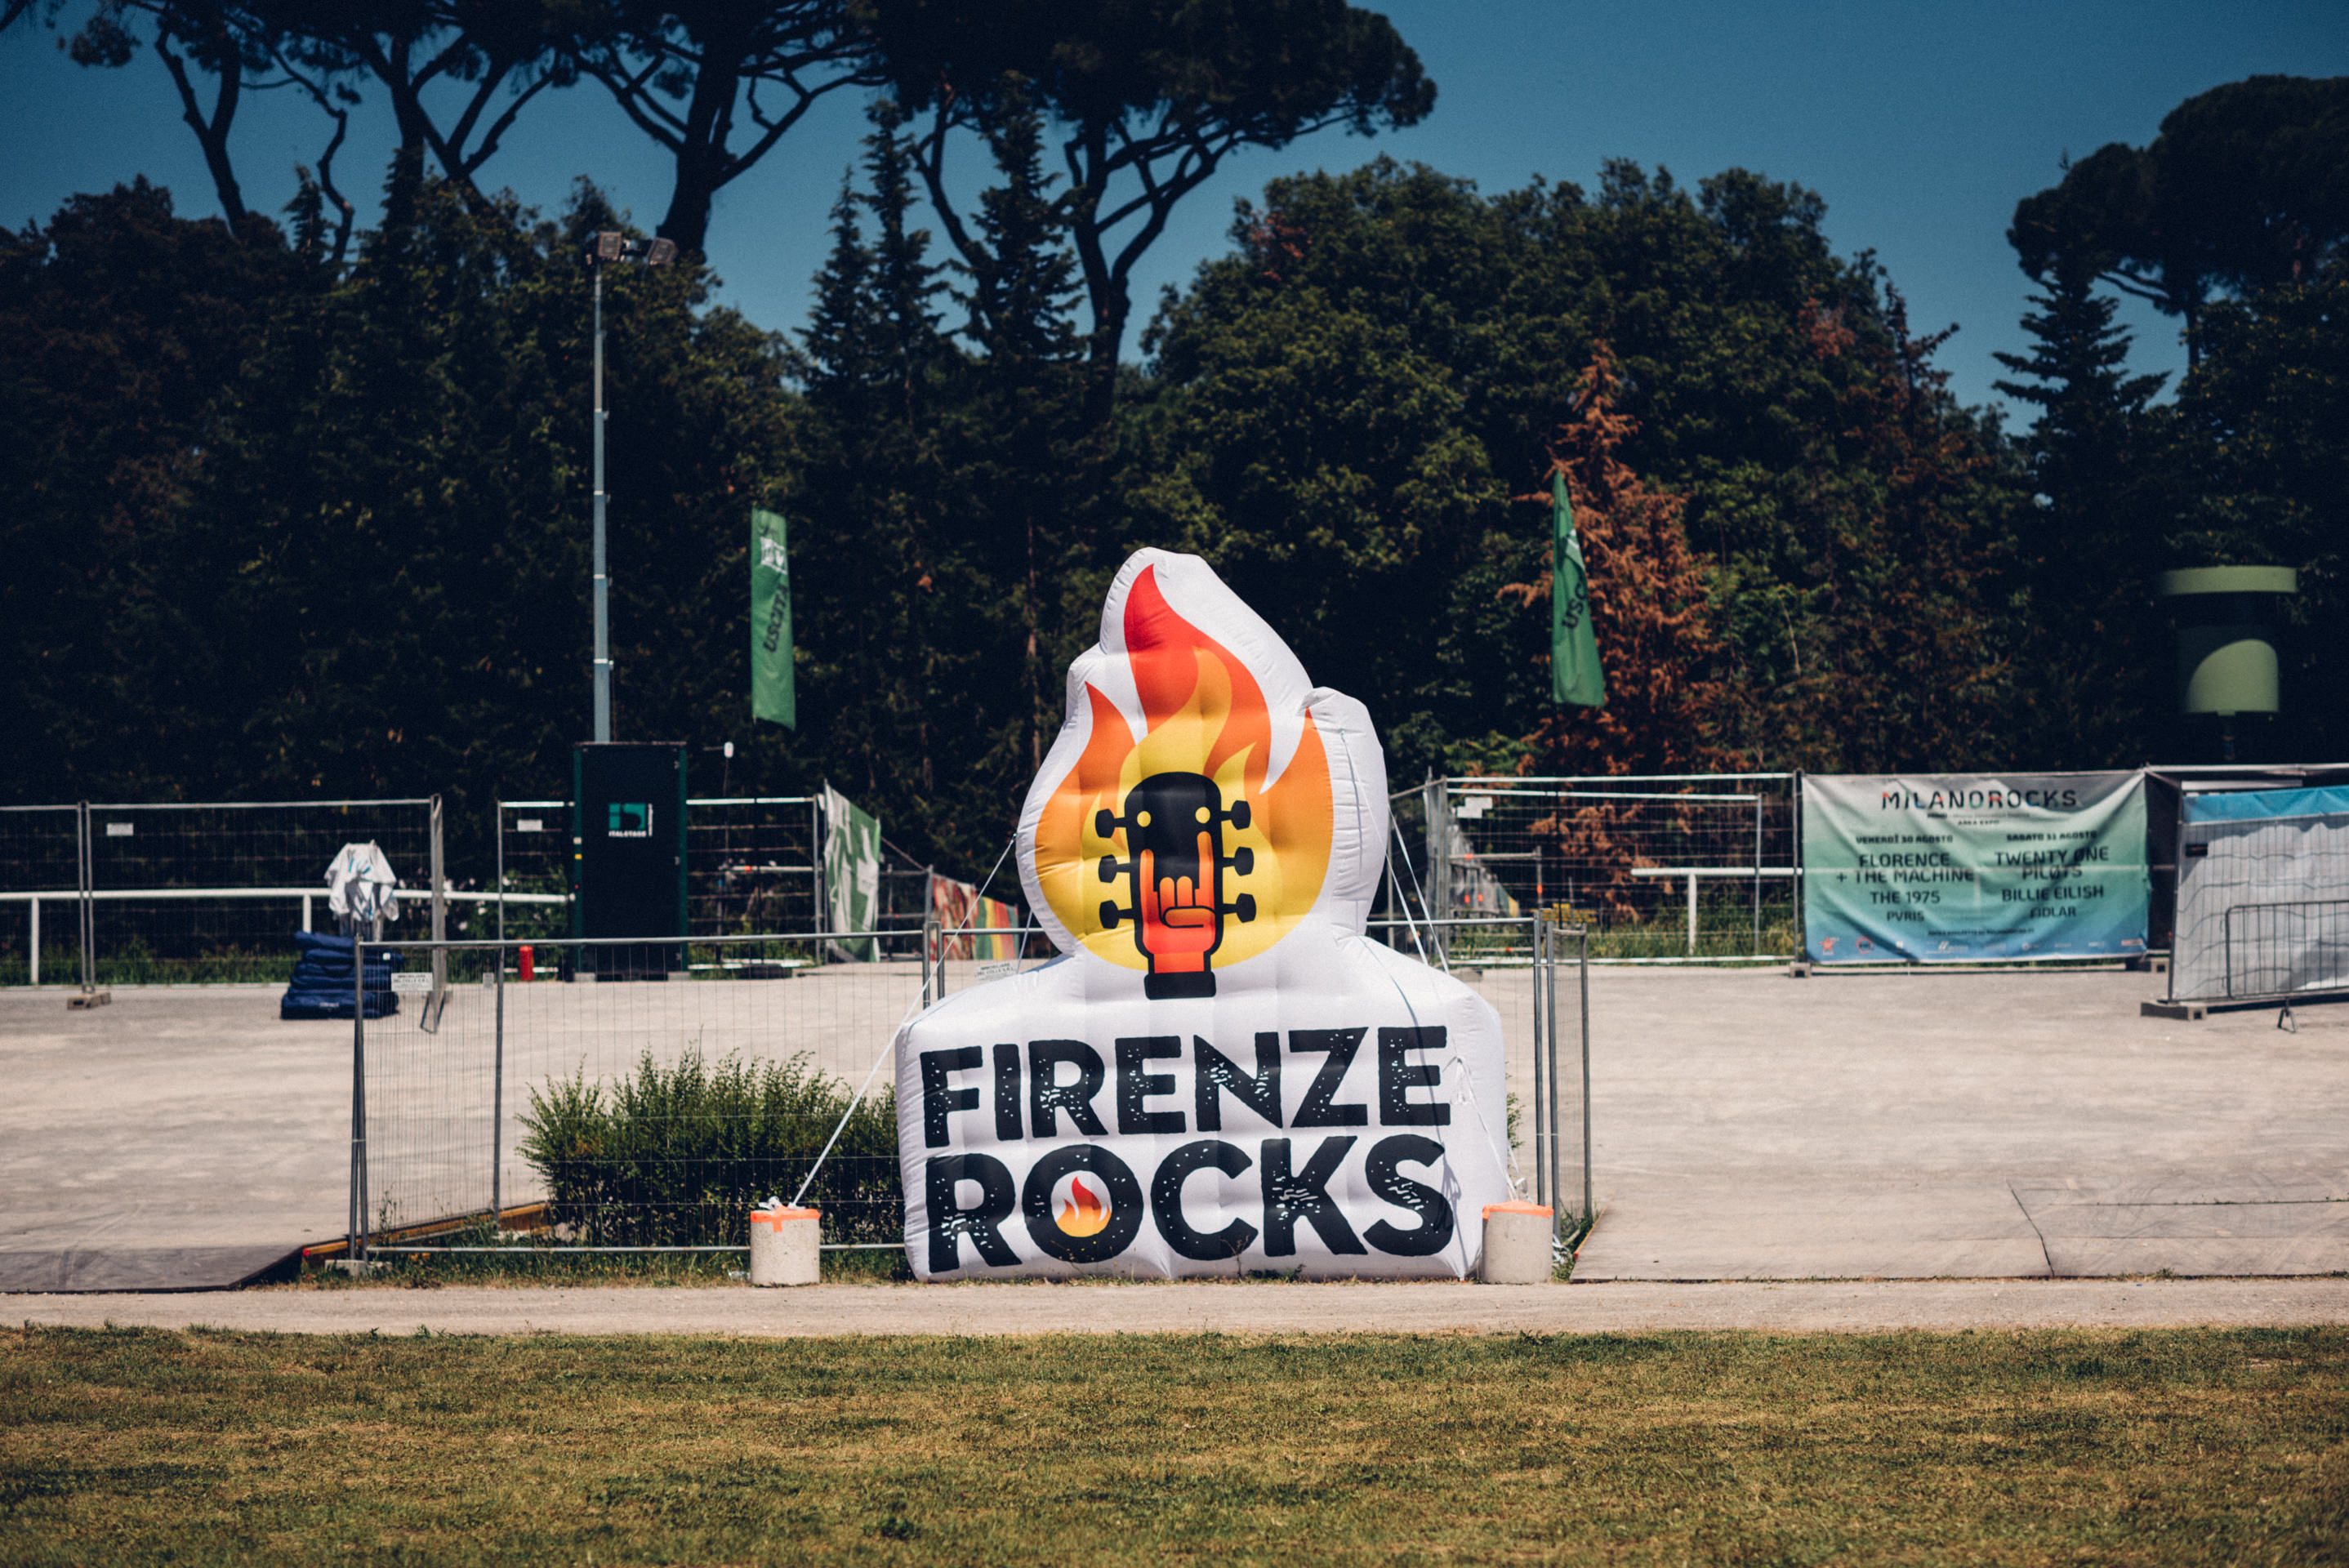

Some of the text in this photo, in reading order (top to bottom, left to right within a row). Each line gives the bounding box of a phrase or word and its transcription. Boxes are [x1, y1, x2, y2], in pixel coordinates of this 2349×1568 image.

[1882, 790, 2076, 809] MILANOROCKS
[1915, 834, 1954, 844] AGOSTO
[1859, 853, 1950, 867] FLORENCE
[1995, 849, 2068, 866] TWENTY
[1837, 868, 1974, 884] + THE MACHINE
[1870, 890, 1941, 904] THE 1975
[2002, 884, 2104, 902] BILLIE EILISH
[1887, 911, 1924, 922] PVRIS
[2030, 906, 2076, 918] FIDLAR
[920, 1026, 1451, 1148] FIRENZE
[925, 1134, 1454, 1273] ROCKS
